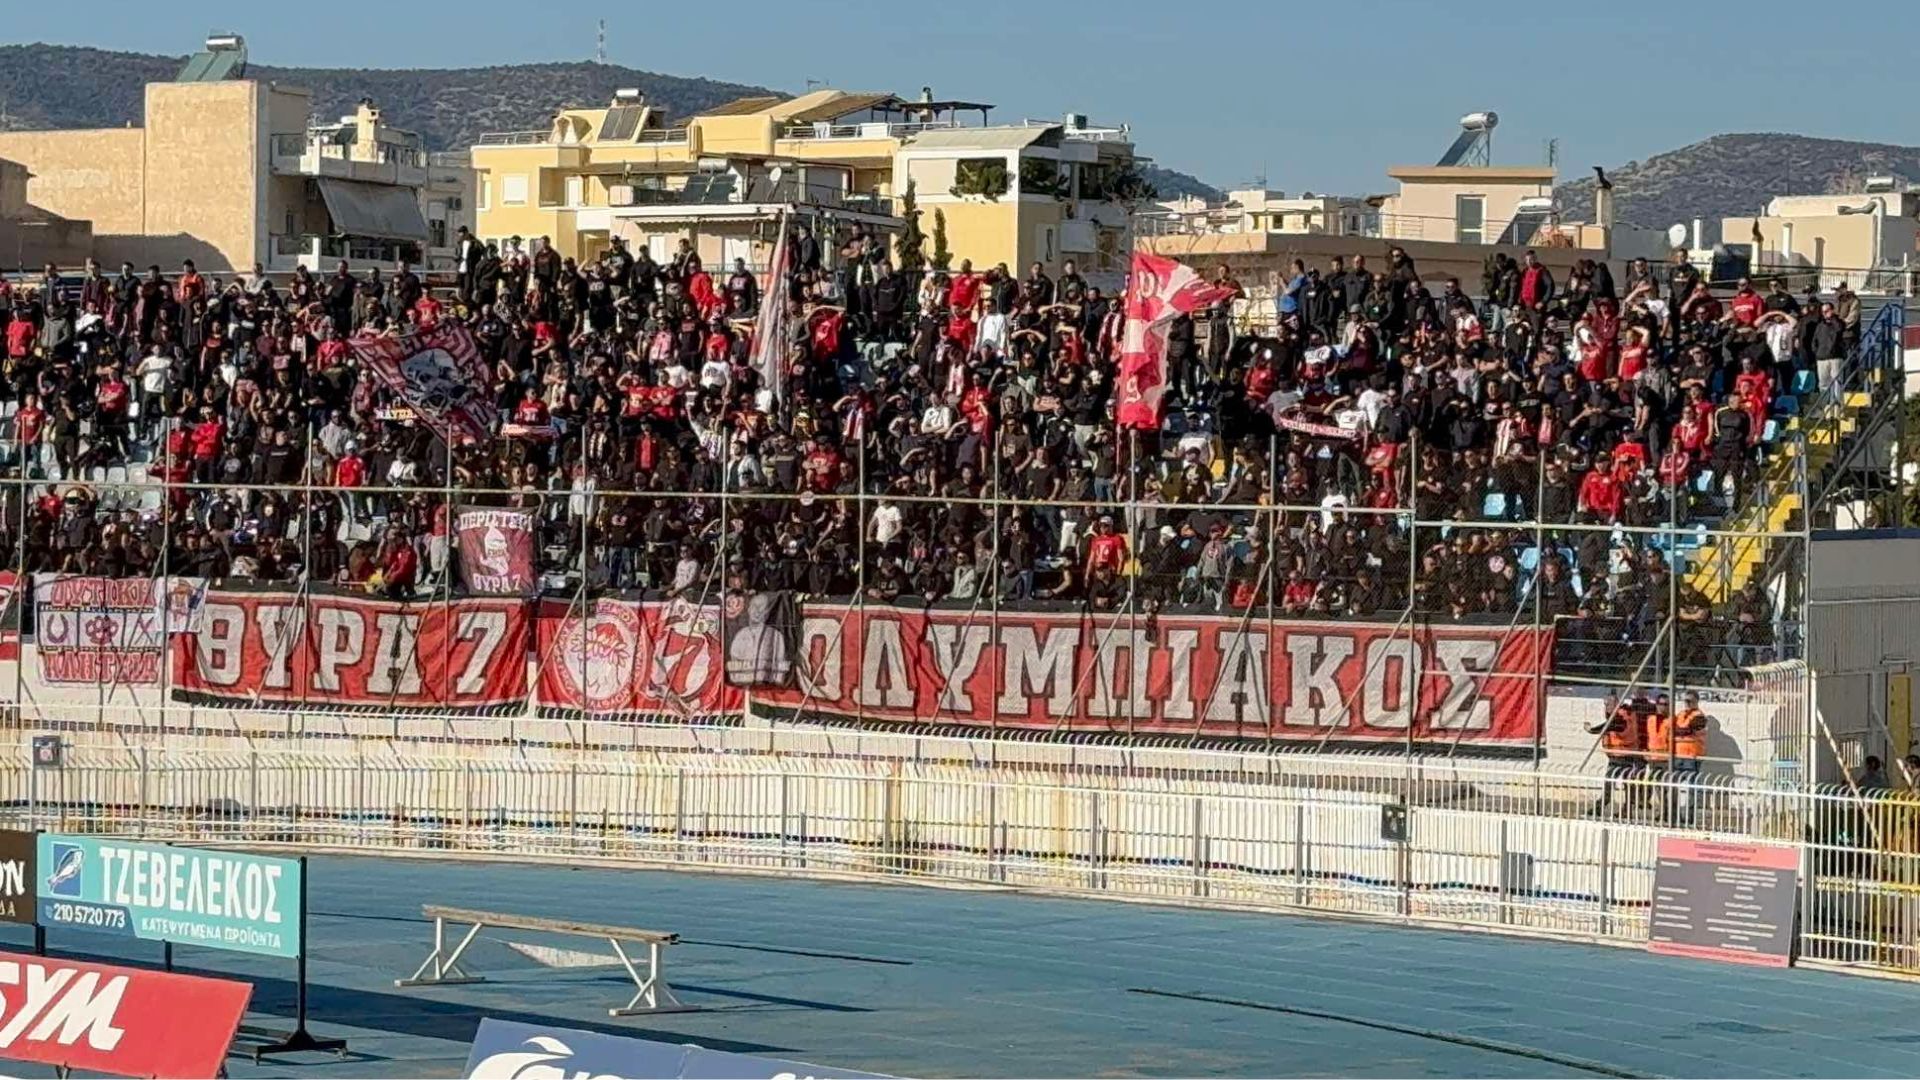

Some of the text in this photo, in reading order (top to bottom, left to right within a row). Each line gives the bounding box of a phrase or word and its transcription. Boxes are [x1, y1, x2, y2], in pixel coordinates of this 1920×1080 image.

[473, 572, 521, 593] ΘΥΡΑ 7
[198, 603, 423, 695] ΘΥΡΑ
[456, 611, 507, 695] 7
[797, 616, 1498, 730] ΟΛΥΜΠΙΑΚΟΣ
[0, 858, 25, 896] N
[99, 846, 282, 923] ΤΖΕΒΕΛΕΚΟΣ
[53, 903, 125, 928] 210 5720 773
[141, 917, 221, 940] ΚΑΤΕΨΥΓΜΕΝΑ
